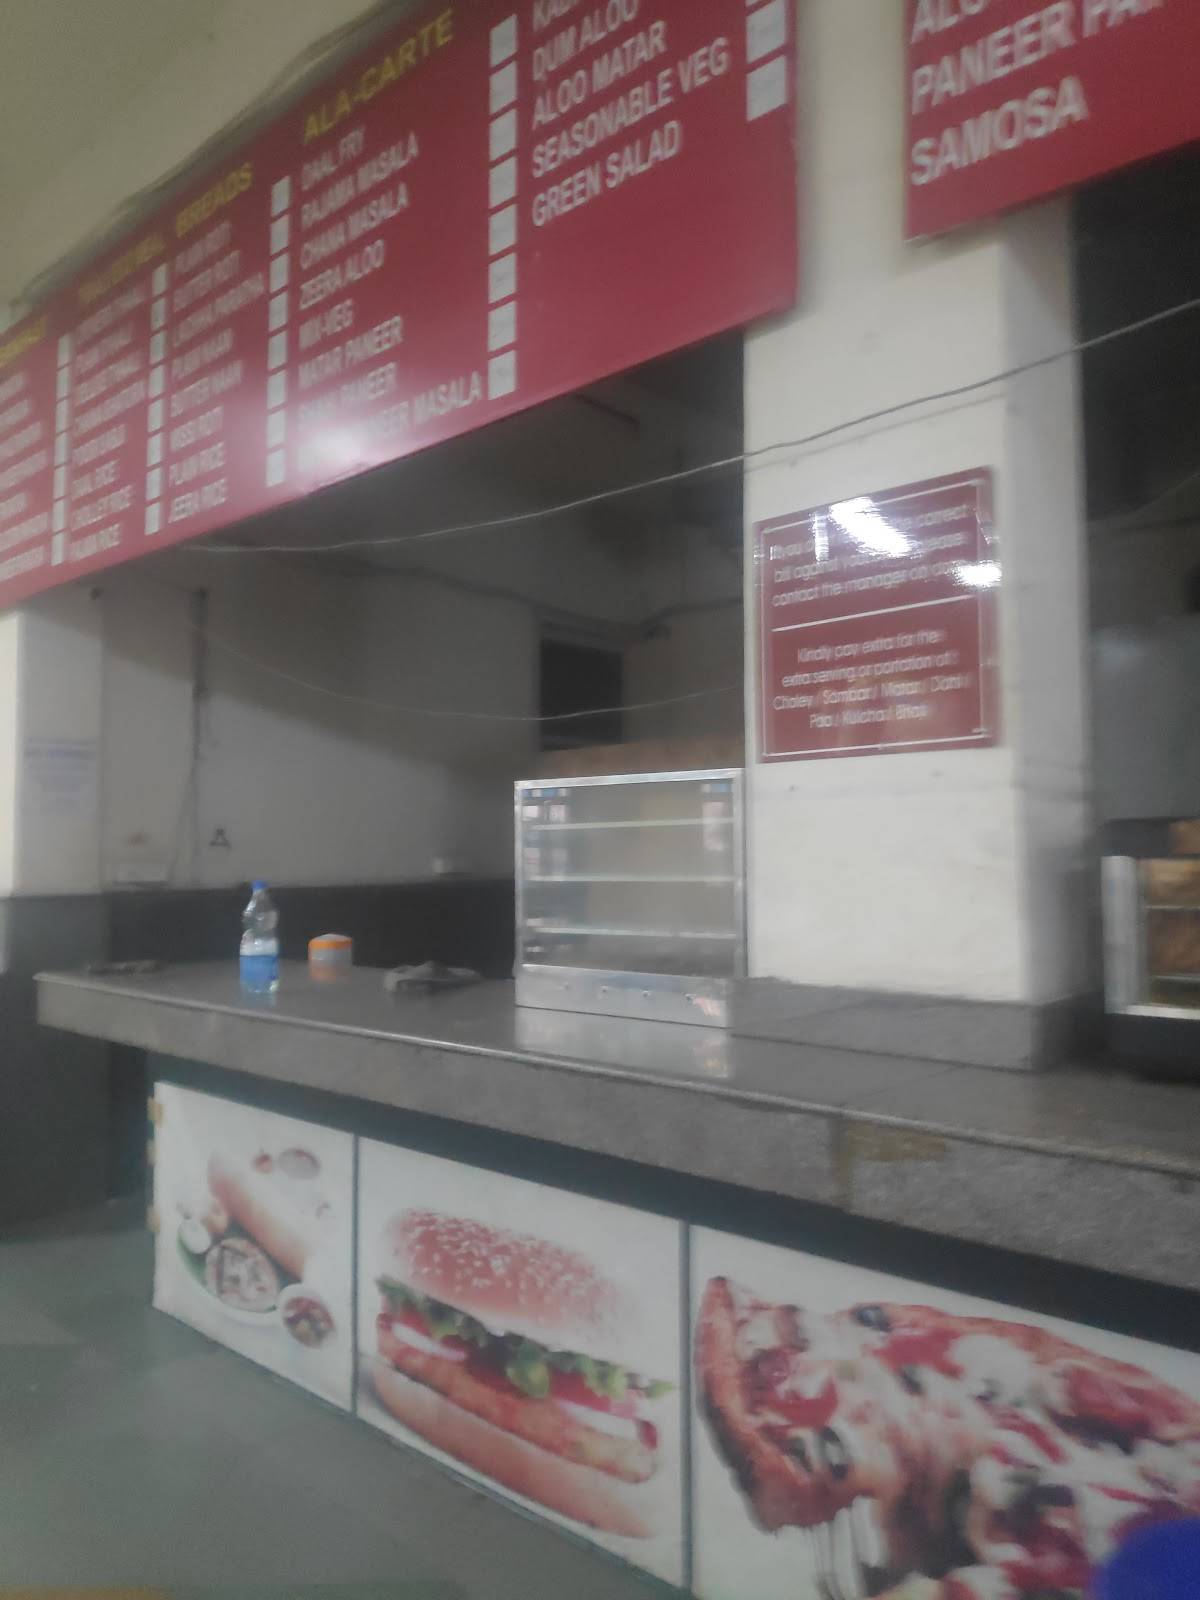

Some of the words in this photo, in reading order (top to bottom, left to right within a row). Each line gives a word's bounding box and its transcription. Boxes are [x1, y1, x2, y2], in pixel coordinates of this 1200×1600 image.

[532, 26, 577, 82] DUM
[580, 0, 641, 51] ALOO
[911, 2, 1078, 115] PANEER
[303, 8, 455, 145] ALA-CARTE
[532, 70, 589, 131] ALOO
[592, 20, 668, 93] MATAR
[532, 68, 674, 178] SEASONABLE
[678, 37, 729, 94] VEG
[911, 75, 1090, 186] SAMOSA
[356, 130, 420, 194] MASALA
[532, 161, 602, 227] GREEN
[606, 120, 683, 188] SALAD
[348, 180, 411, 241] MASALA
[344, 238, 385, 282] ALOO
[344, 315, 404, 368] PANEER
[413, 370, 483, 427] MASALA
[772, 586, 819, 607] contact
[822, 581, 842, 597] the
[843, 570, 908, 591] manager
[797, 645, 831, 662] Kindly
[835, 642, 859, 660] pay
[862, 637, 894, 654] extra
[896, 632, 915, 649] for
[917, 629, 944, 646] the
[773, 694, 813, 711] Choley
[823, 687, 872, 705] Sambar
[782, 672, 811, 688] extra
[813, 666, 859, 684] serving
